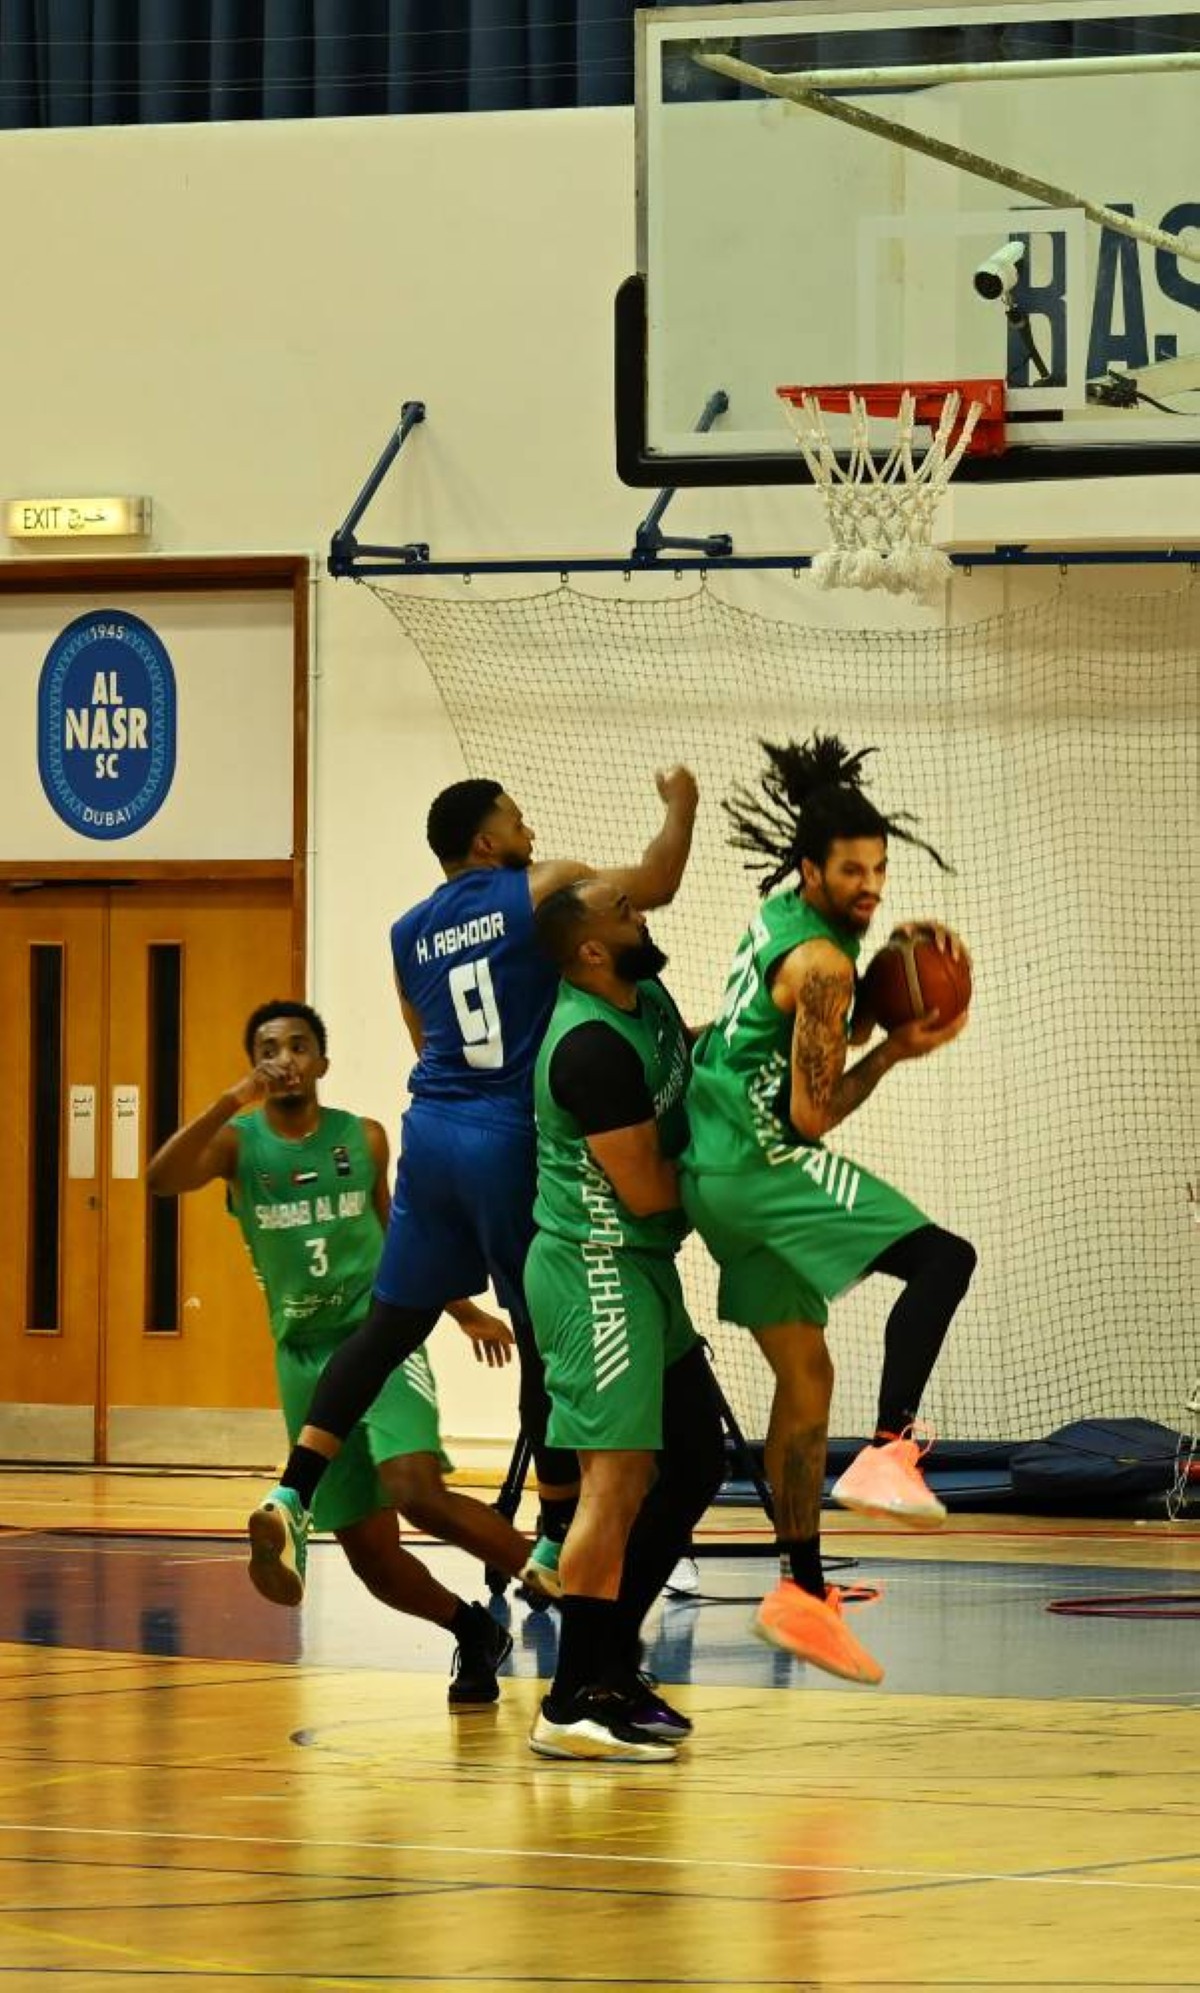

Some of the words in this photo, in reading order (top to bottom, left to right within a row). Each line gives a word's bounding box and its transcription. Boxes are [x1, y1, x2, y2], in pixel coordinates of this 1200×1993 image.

[23, 506, 62, 530] EXIT
[90, 624, 124, 640] 1945
[91, 671, 123, 705] AL
[65, 707, 148, 750] NASR
[95, 753, 119, 779] SC
[81, 806, 133, 827] DUBAI
[416, 937, 432, 965] H.
[433, 911, 505, 958] ASHOOR
[448, 957, 504, 1068] 9
[305, 1238, 328, 1277] 3
